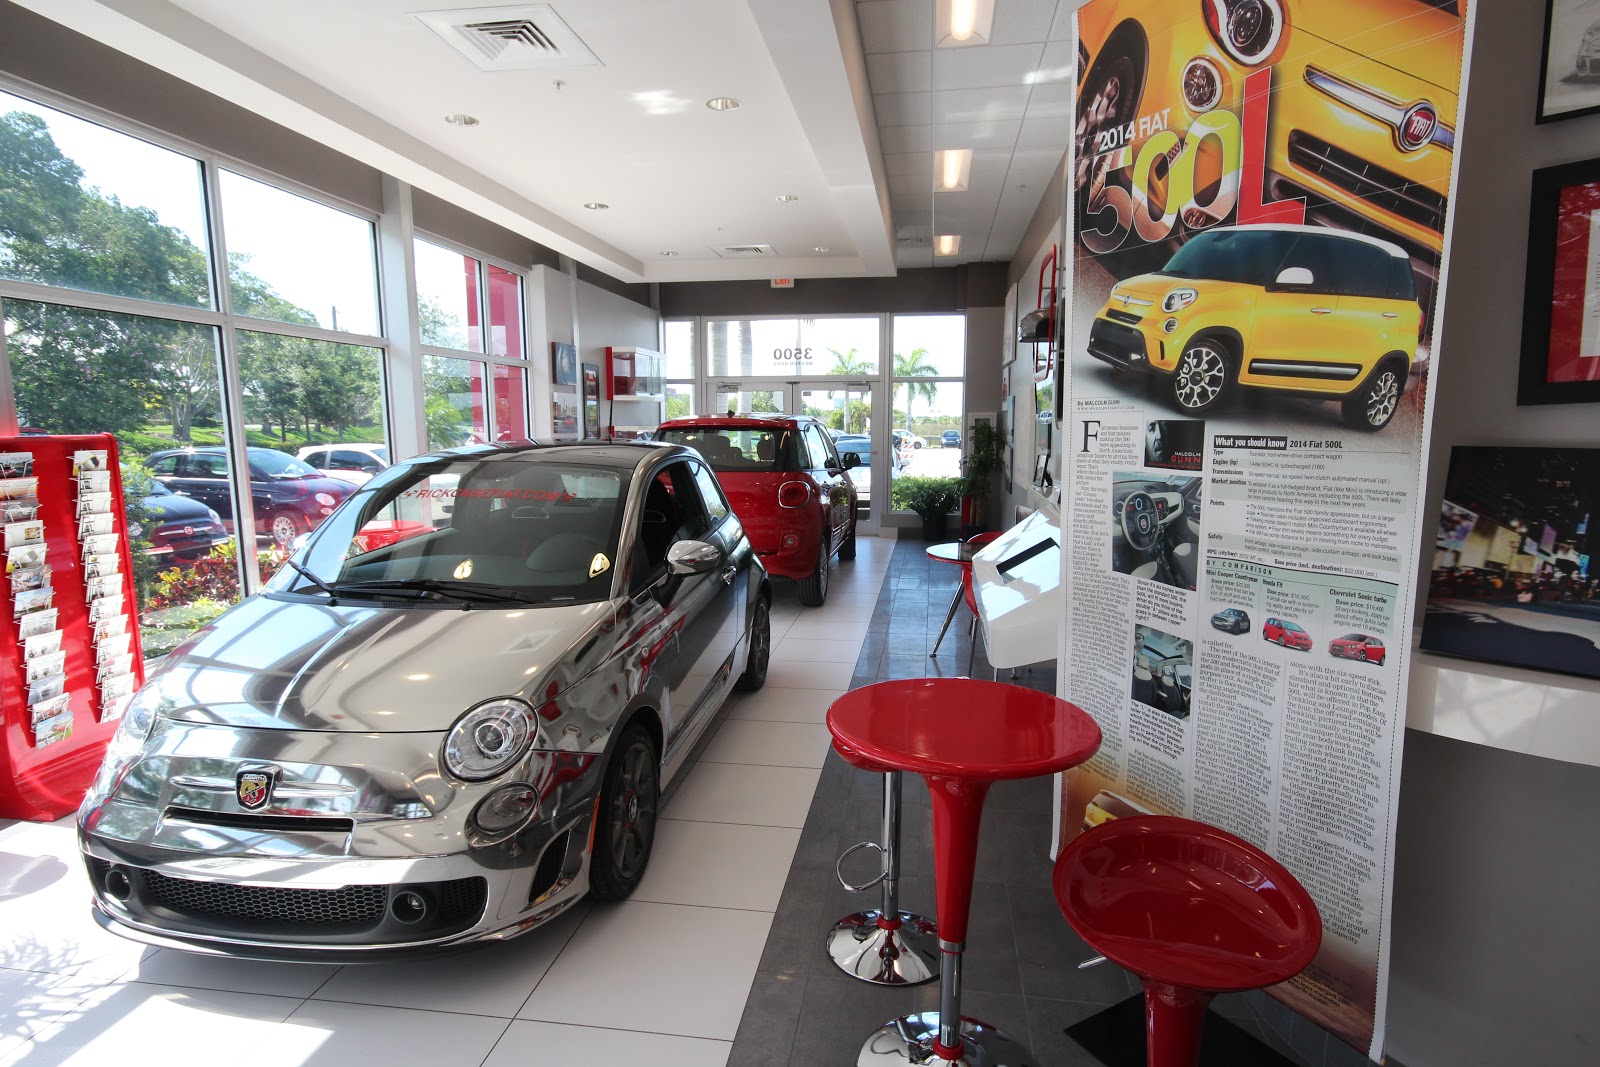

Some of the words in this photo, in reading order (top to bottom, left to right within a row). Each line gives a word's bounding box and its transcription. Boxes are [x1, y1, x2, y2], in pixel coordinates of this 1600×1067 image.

[1100, 122, 1136, 152] 2014
[1140, 109, 1170, 139] FIAT
[1410, 112, 1431, 138] FIAT
[1081, 66, 1306, 254] 500L
[1215, 437, 1233, 446] What
[1235, 440, 1246, 448] you
[1247, 438, 1266, 447] should
[1267, 438, 1286, 447] know
[416, 489, 560, 501] RICKCASEFIAT.COM
[1207, 532, 1223, 541] Safety
[1222, 562, 1272, 575] COMPARISON
[1311, 563, 1344, 573] destination):
[1234, 573, 1258, 582] Countryman
[1329, 589, 1356, 598] Chevrolet
[1374, 596, 1387, 604] turbo
[1369, 625, 1385, 634] airbags.
[1337, 670, 1366, 682] six-speed
[1341, 679, 1358, 688] early
[1366, 684, 1387, 694] discuss
[1314, 768, 1349, 784] Trekking's
[1351, 780, 1367, 790] build
[1300, 773, 1320, 782] which
[1321, 779, 1342, 790] pretty
[1342, 786, 1361, 795] much
[1361, 790, 1379, 802] limits
[1290, 781, 1308, 791] Other
[1309, 788, 1334, 800] up-level
[1335, 797, 1368, 812] equipment
[1327, 787, 1353, 801] actually
[1354, 795, 1366, 804] trek
[1296, 817, 1324, 830] premium
[1326, 827, 1343, 838] Beats
[1344, 834, 1352, 843] by
[1363, 841, 1374, 851] Dre
[1286, 825, 1309, 840] Pricing
[1316, 838, 1344, 852] expected
[1352, 853, 1369, 863] come
[1332, 929, 1358, 944] capacity.
